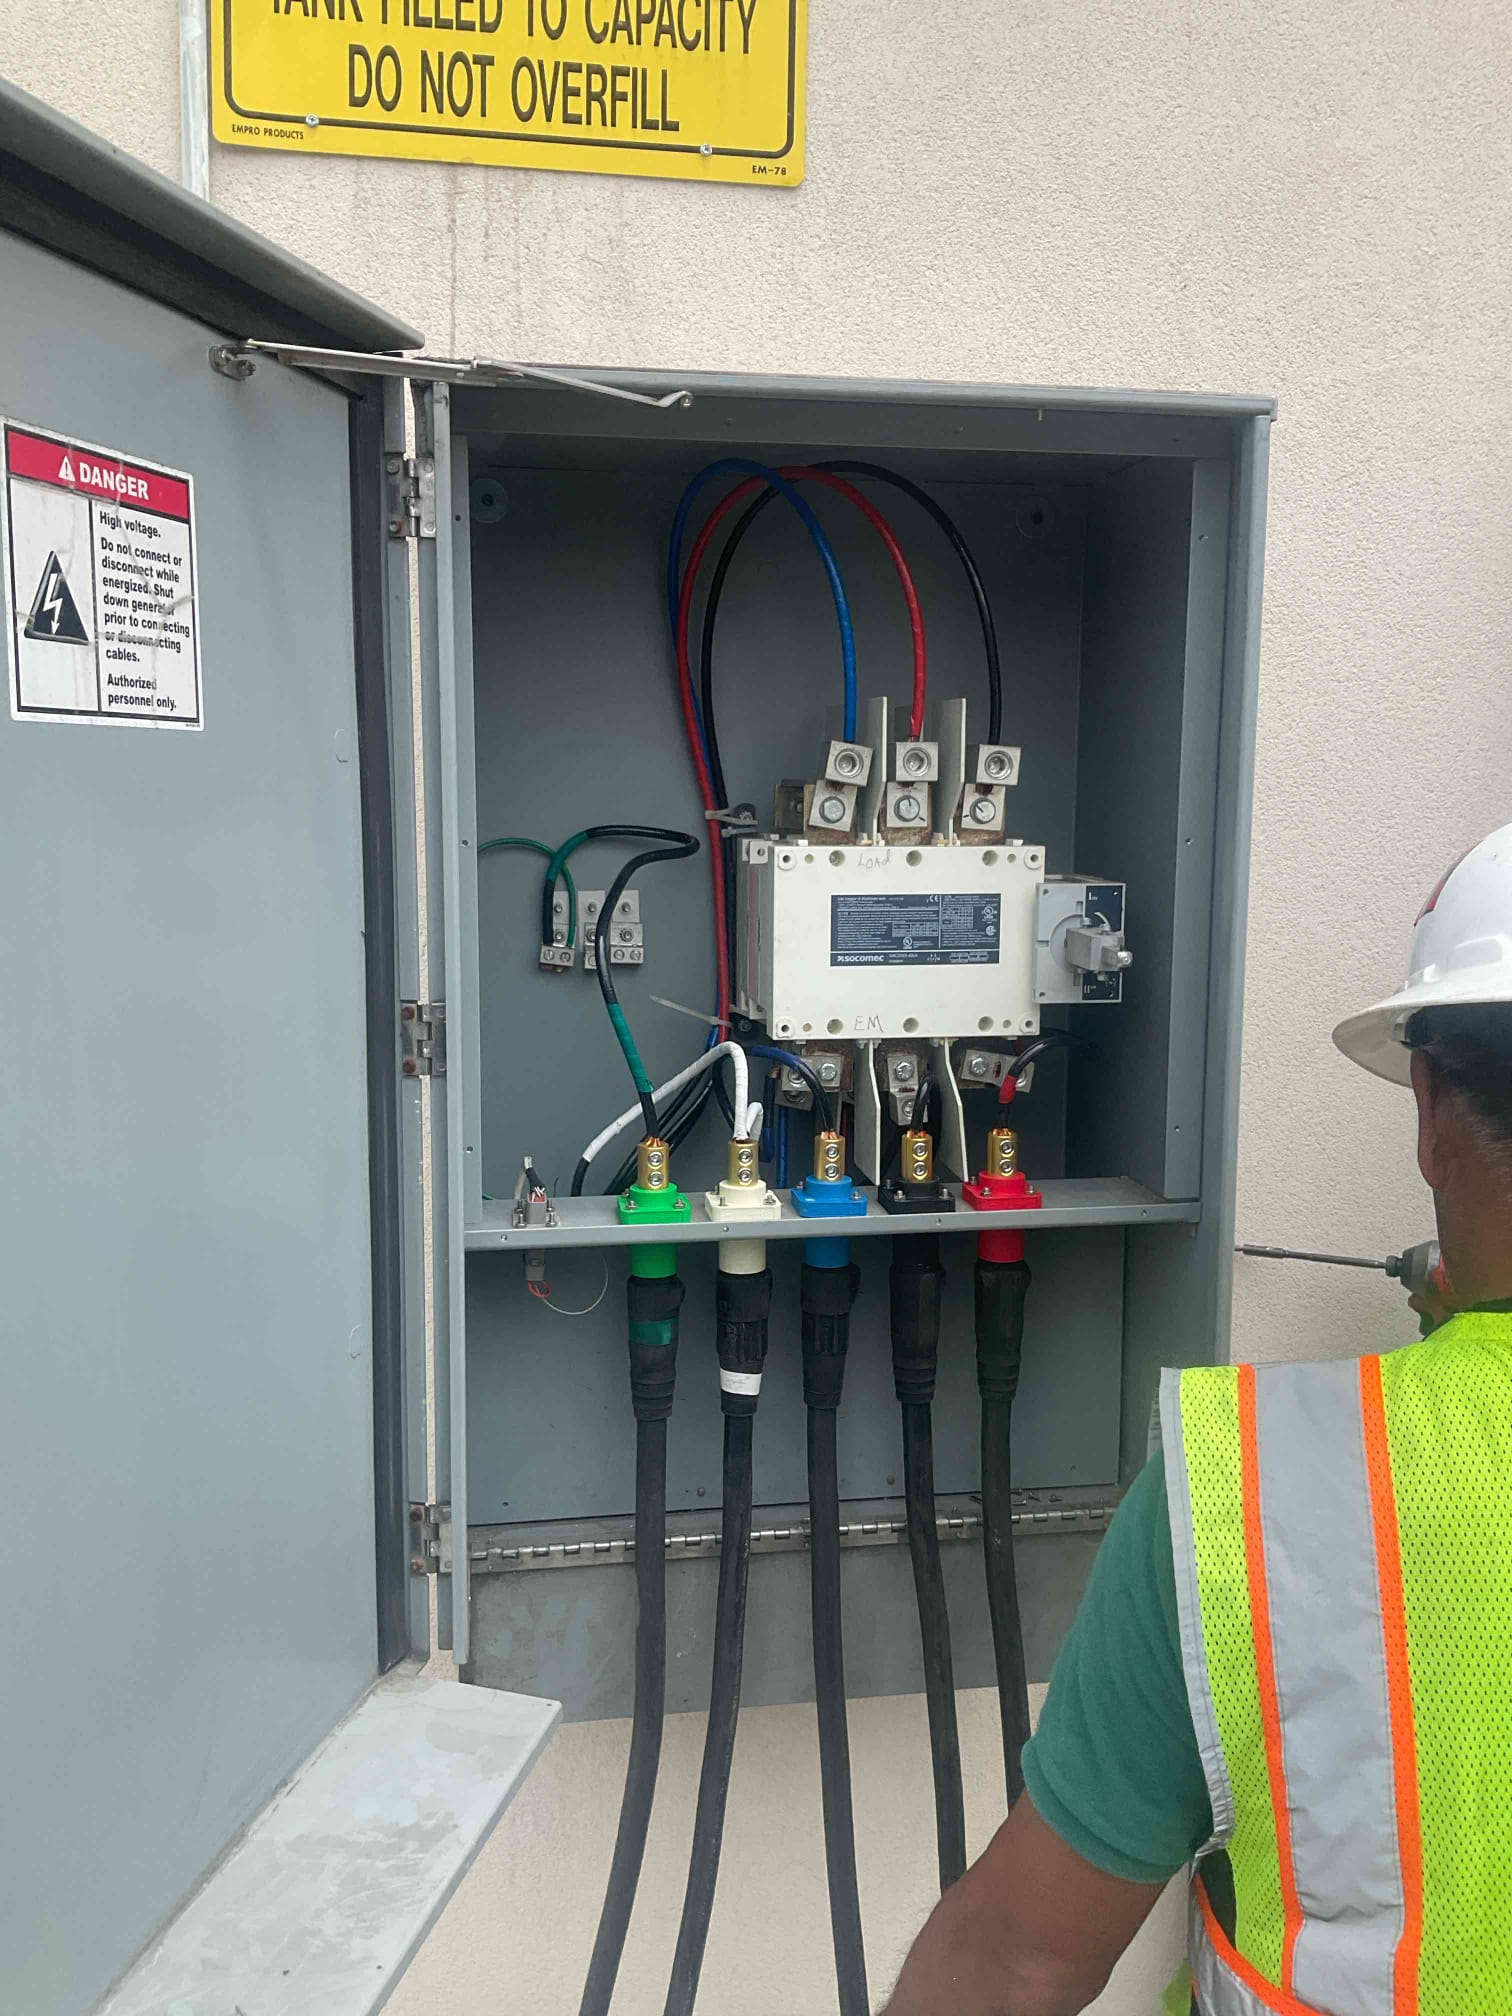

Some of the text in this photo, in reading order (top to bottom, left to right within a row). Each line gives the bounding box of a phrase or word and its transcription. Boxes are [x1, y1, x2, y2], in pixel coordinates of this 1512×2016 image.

[585, 0, 756, 54] CAPACITY
[348, 43, 680, 132] DO NOT OVERFILL
[232, 123, 304, 140] EMPRO PRODUCTS
[752, 164, 787, 176] EM-78
[79, 462, 149, 500] DANGER
[99, 510, 161, 539] High voltage.
[100, 536, 114, 552] Do
[134, 547, 171, 565] connect
[173, 555, 183, 567] or
[101, 555, 180, 583] disconnect while
[102, 576, 174, 599] energized. Shut
[103, 592, 129, 608] down
[104, 611, 190, 638] prior to conecting
[105, 647, 141, 662] cables.
[106, 672, 157, 691] Authorized
[107, 693, 177, 712] personnel only.
[844, 954, 884, 962] socomec
[854, 1015, 884, 1033] EM
